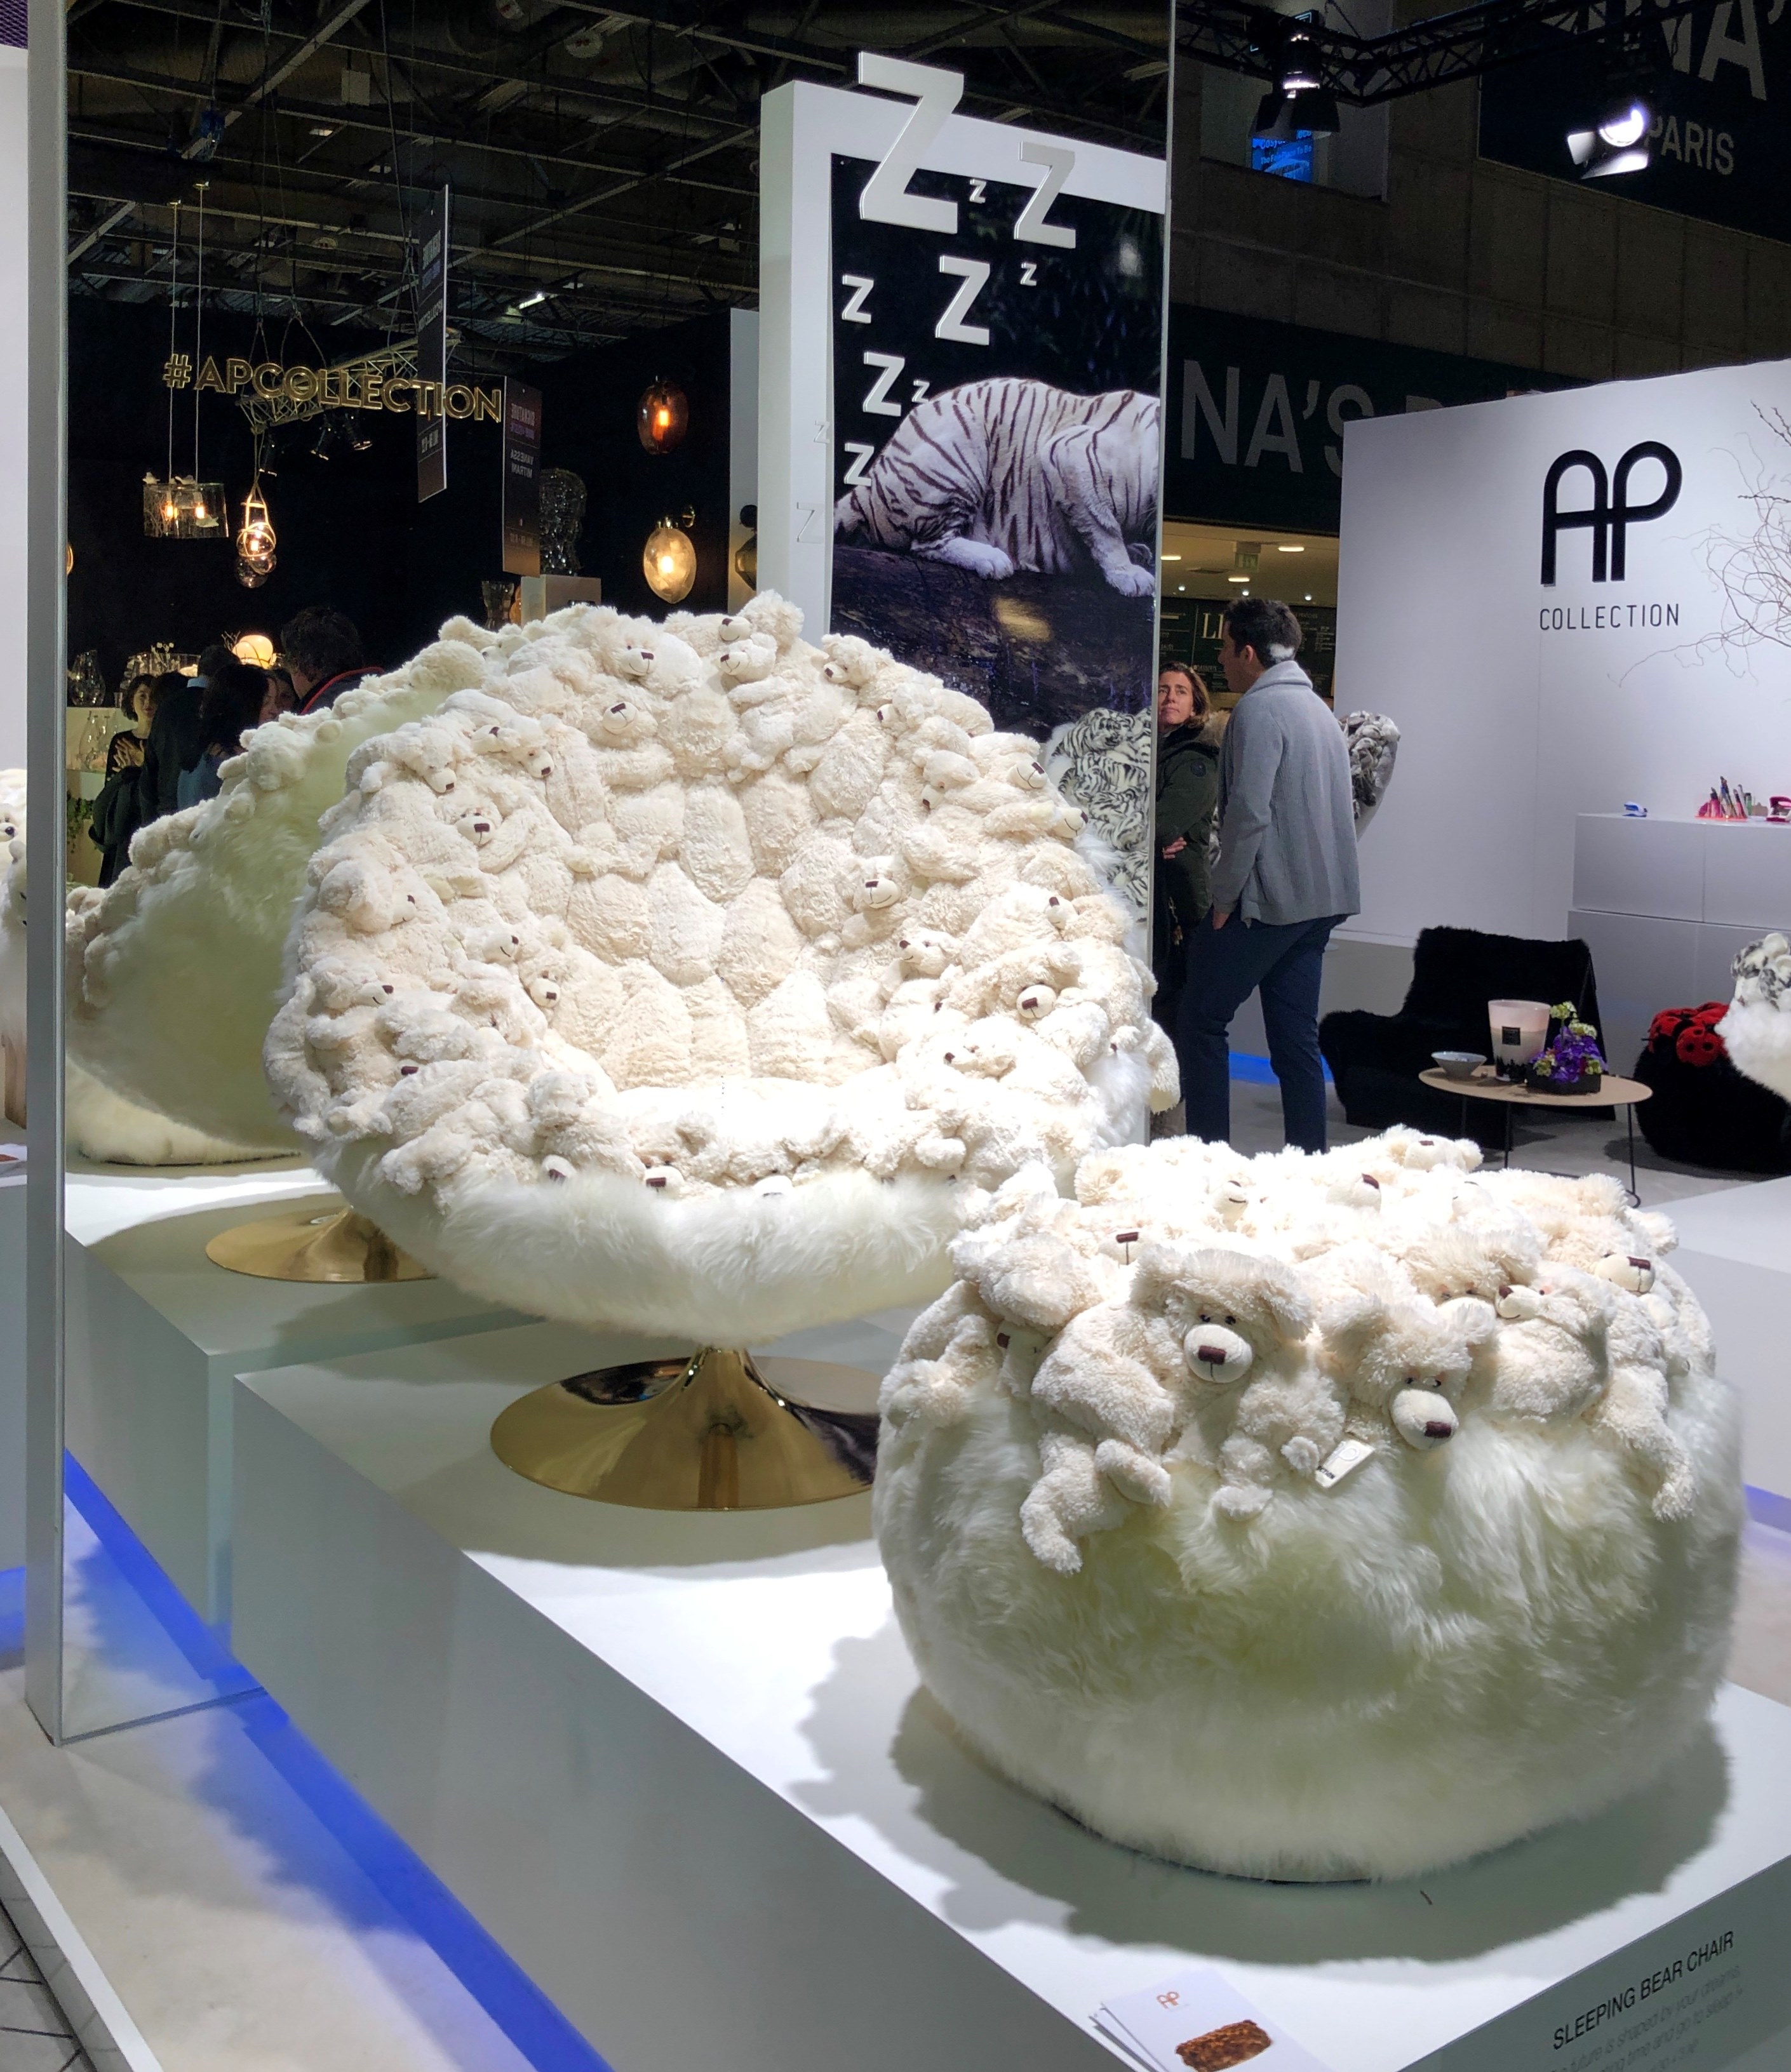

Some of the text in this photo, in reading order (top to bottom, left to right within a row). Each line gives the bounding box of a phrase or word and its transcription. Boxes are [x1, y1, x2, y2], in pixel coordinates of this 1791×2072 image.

[164, 353, 502, 424] #APCOLLECTION
[1541, 441, 1682, 587] AP
[1539, 603, 1679, 631] COLLECTION
[1553, 1930, 1734, 2050] SLEEPING BEAR CHAIR
